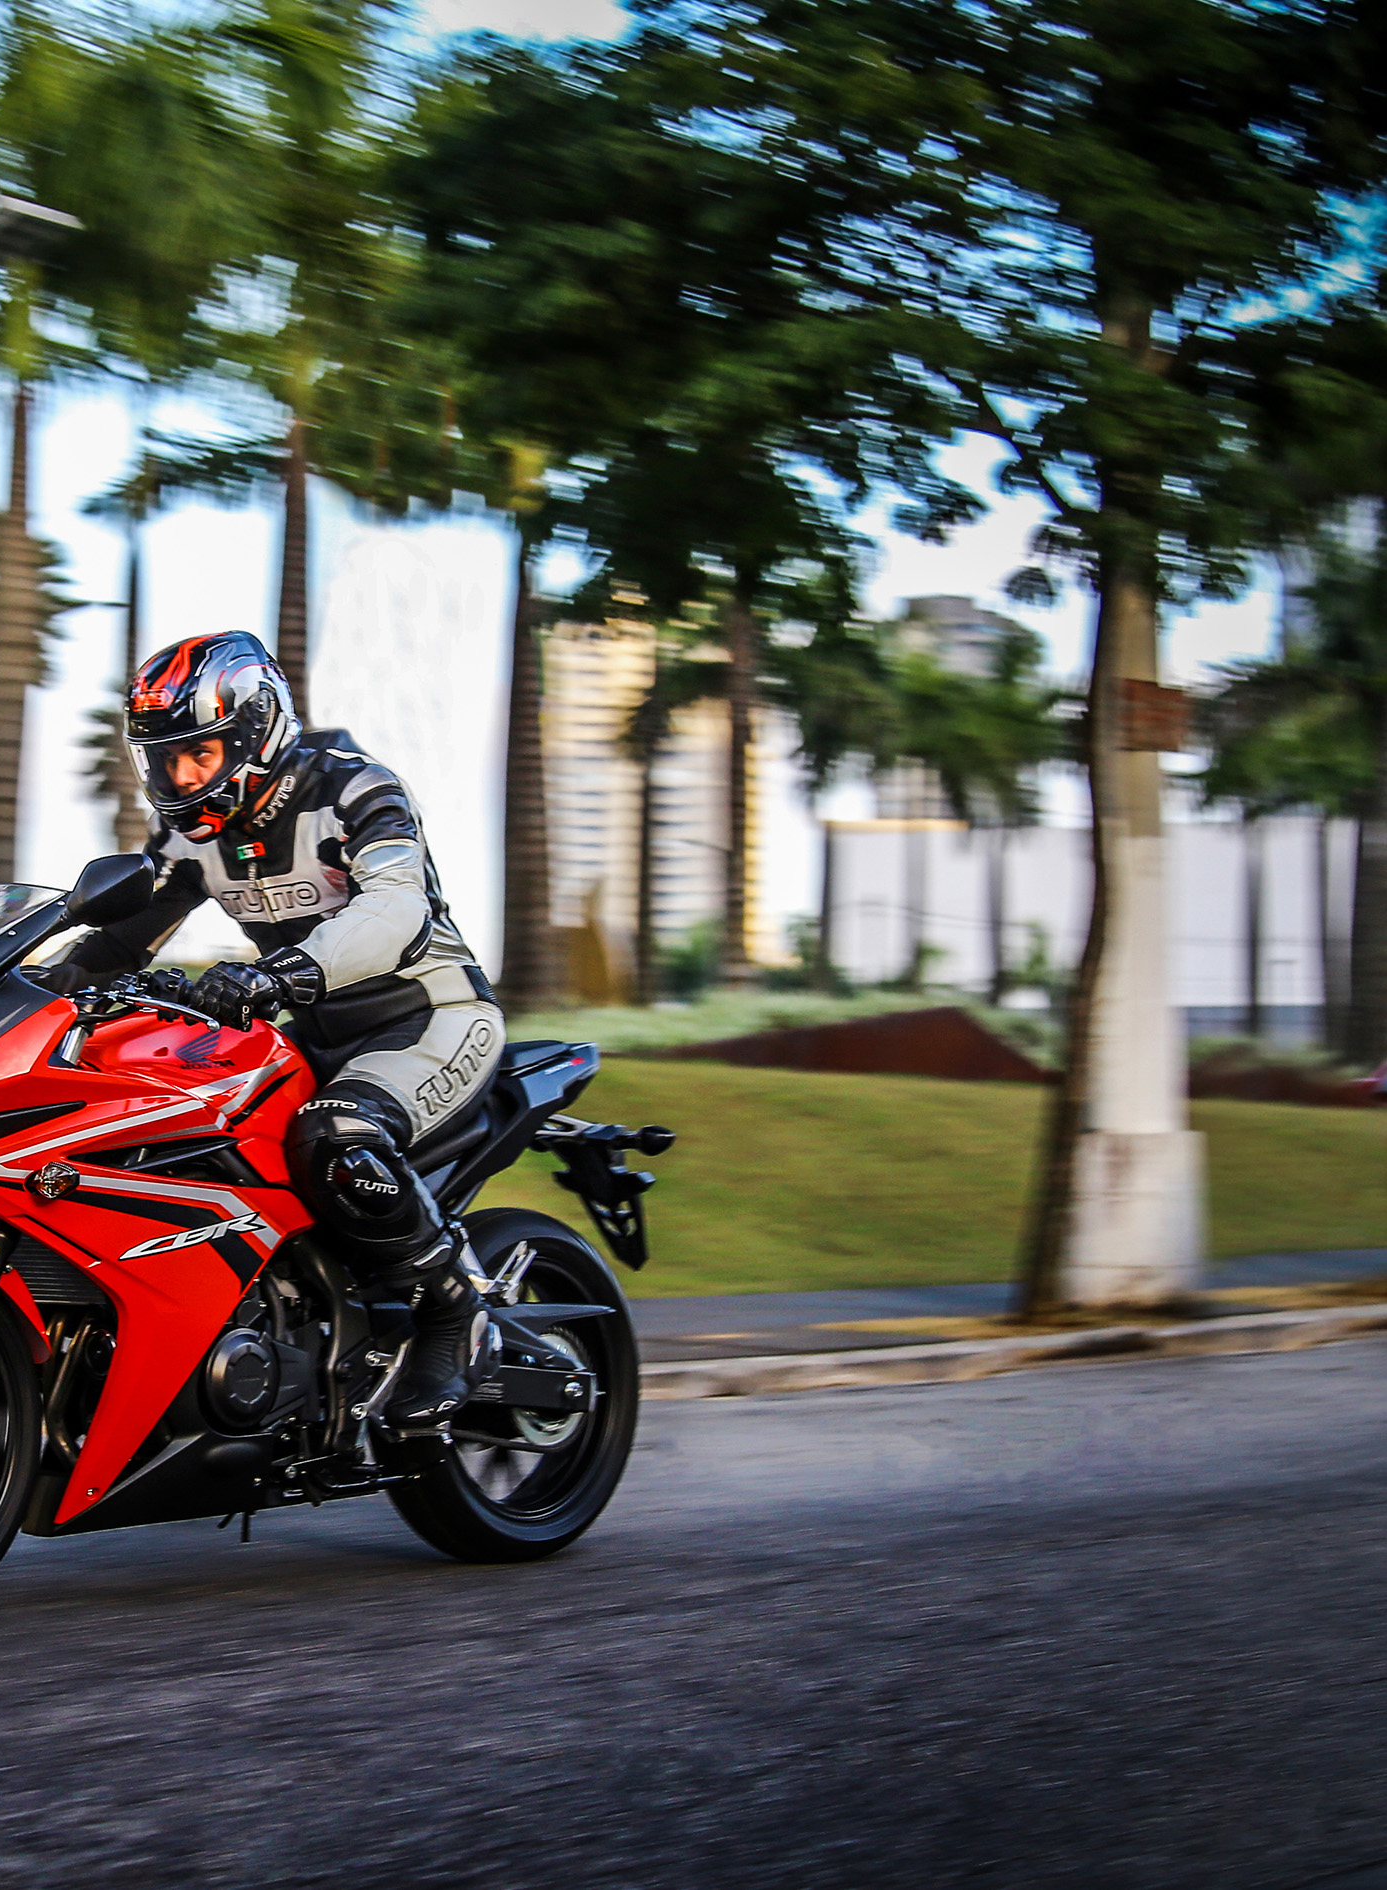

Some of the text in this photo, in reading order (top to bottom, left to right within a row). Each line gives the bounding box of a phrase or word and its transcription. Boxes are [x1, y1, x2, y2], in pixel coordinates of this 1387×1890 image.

[252, 775, 296, 828] TUTTO
[220, 880, 321, 916] TUTTO
[272, 954, 303, 968] TUTTO
[415, 1018, 497, 1116] TUTTO
[297, 1099, 359, 1116] TUTTO
[353, 1178, 400, 1195] TUTTO
[118, 1211, 267, 1261] CBR
